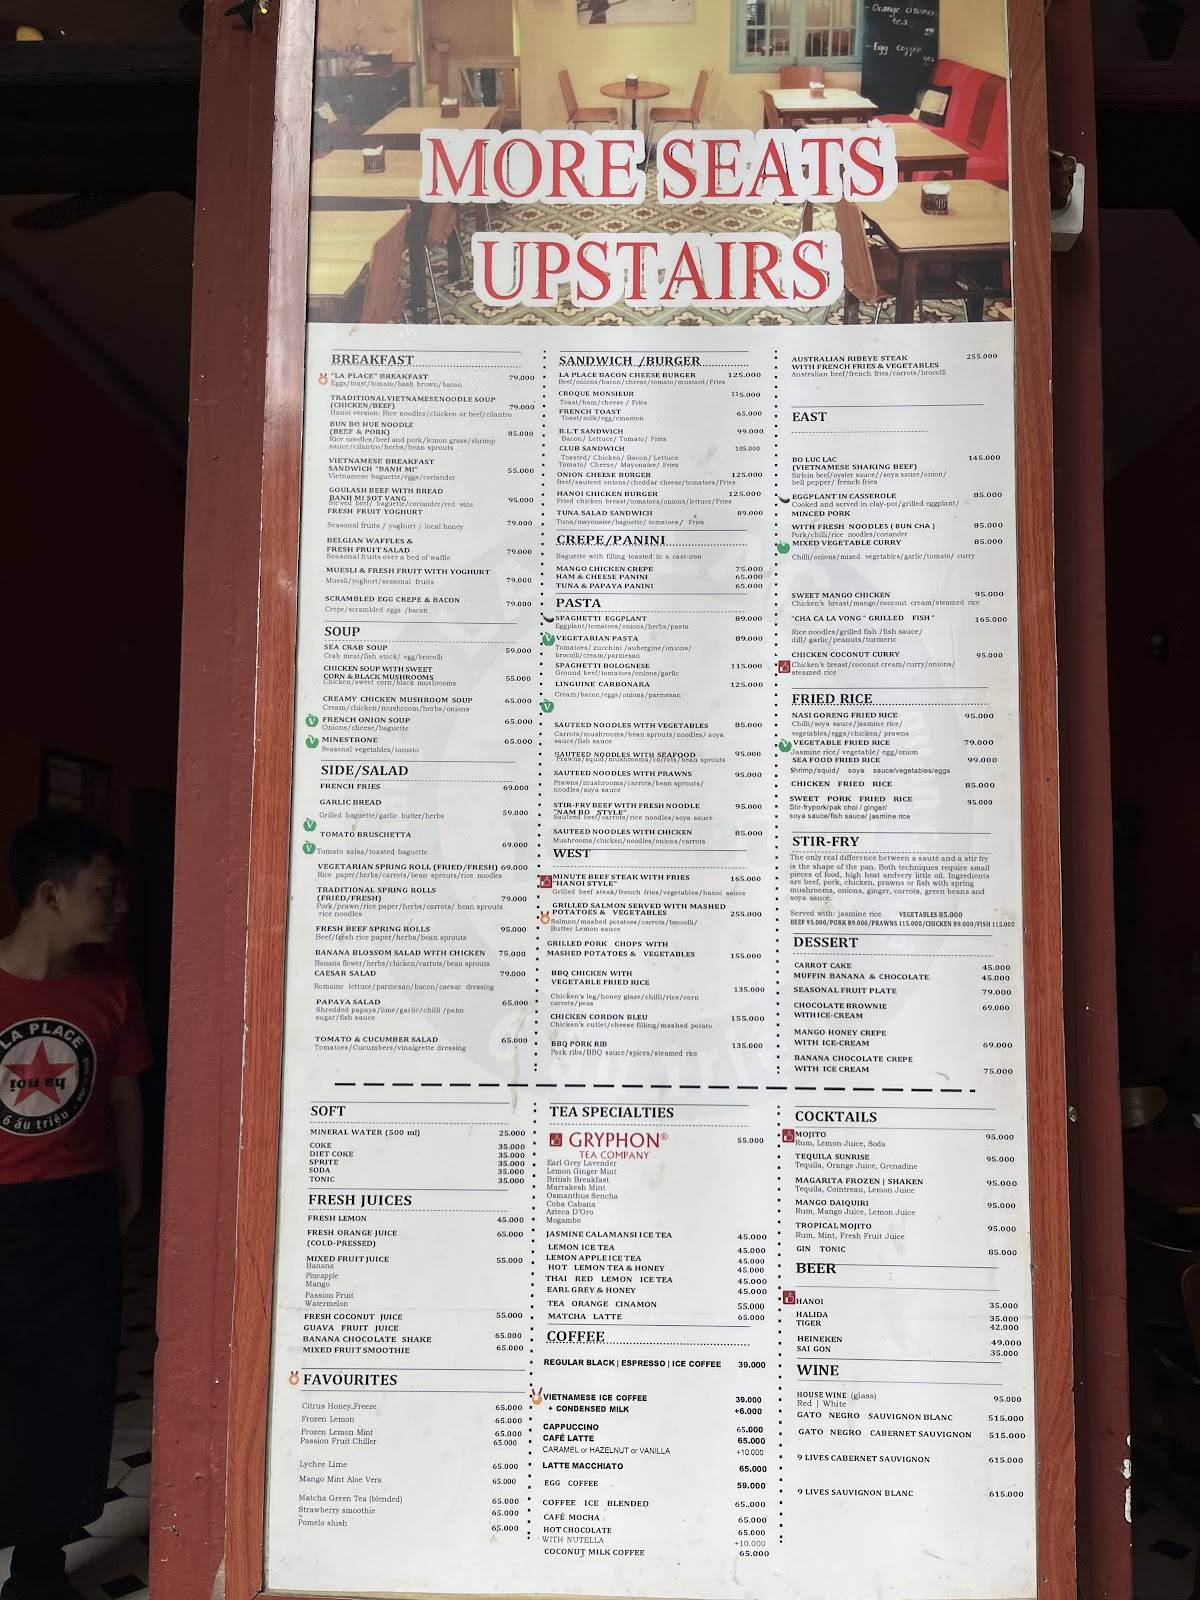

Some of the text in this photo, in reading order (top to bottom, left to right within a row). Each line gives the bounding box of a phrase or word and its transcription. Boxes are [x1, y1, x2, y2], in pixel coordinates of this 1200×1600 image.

[428, 135, 887, 199] MORE SEATS
[479, 238, 829, 302] UPSTAIRS
[331, 354, 415, 365] BREAKFAST
[559, 355, 702, 368] SANDWICH /BURGER
[508, 374, 535, 382] 79.000
[792, 411, 828, 422] EAST
[328, 457, 383, 465] VIETNAMESE
[556, 534, 667, 547] CREPE/PANINI
[556, 598, 602, 608] PASTA
[324, 626, 361, 637] SOUP
[791, 693, 873, 704] FRIED RICE
[320, 764, 409, 778] SIDE/SALAD
[792, 836, 860, 847] STIR-FRY
[553, 848, 592, 858] WEST
[793, 936, 859, 948] DESSERT
[550, 1013, 587, 1021] CHICKEN
[589, 1013, 625, 1021] CORDON
[0, 1022, 85, 1050] LA PLACE
[310, 1105, 346, 1117] SOFT
[549, 1106, 675, 1119] TEA SPECIALTIES
[2, 1114, 13, 1126] 6
[794, 1111, 878, 1123] COCKTAILS
[310, 1128, 526, 1137] MINERAL WATER (500 ml) 25.000
[579, 1150, 650, 1160] TEA COMPANY
[309, 1158, 339, 1166] SPRITE
[546, 1159, 562, 1167] Earl
[563, 1160, 582, 1168] Grey
[497, 1177, 525, 1185] 35.000
[308, 1194, 413, 1208] FRESH JUICES
[795, 1263, 837, 1274] BEER
[305, 1272, 339, 1280] Pineapple
[989, 1302, 1019, 1310] 35.000
[989, 1324, 1019, 1332] 42.000
[546, 1330, 605, 1343] COFFEE
[796, 1364, 840, 1376] WINE
[303, 1374, 398, 1386] FAVOURITES
[543, 1393, 596, 1401] VIETNAMESE
[615, 1394, 648, 1402] COFFEE
[850, 1392, 877, 1401] (glass)
[993, 1395, 1022, 1403] 95.000
[542, 1423, 764, 1434] CAPPUCCINO 65.000
[542, 1433, 766, 1445] CAFÉ LATTE 65.000
[542, 1446, 579, 1454] CARAMEL
[639, 1447, 671, 1455] VANILLA
[736, 1448, 764, 1456] +10.000
[299, 1476, 325, 1484] Mango
[365, 1476, 382, 1484] Vera
[797, 1488, 803, 1496] 9
[831, 1489, 882, 1497] SAUVIGNON
